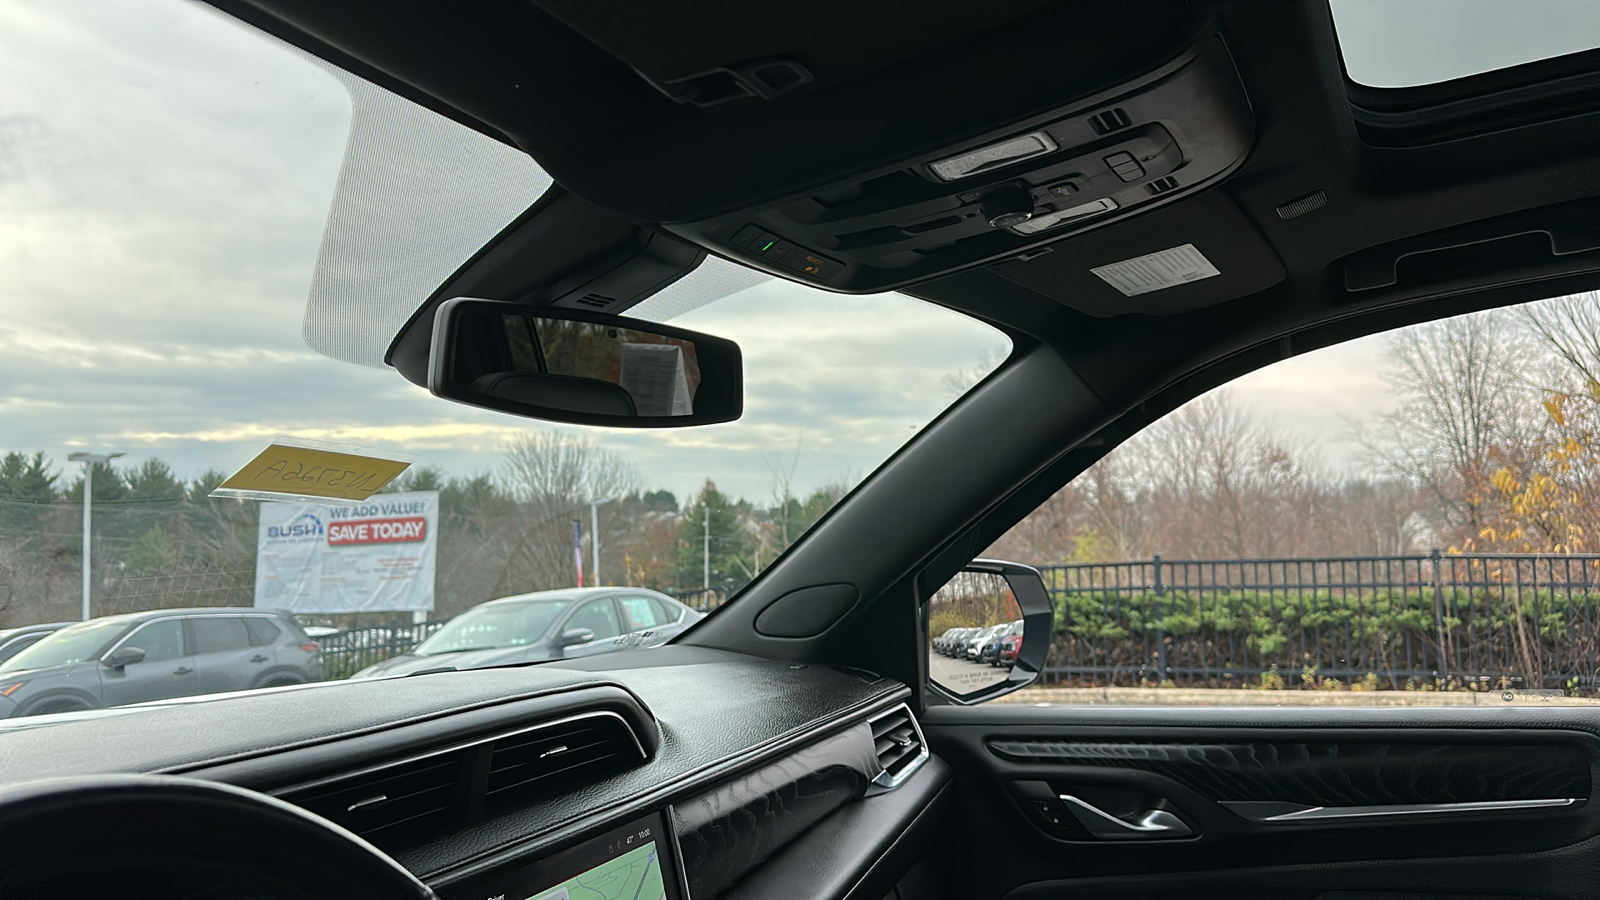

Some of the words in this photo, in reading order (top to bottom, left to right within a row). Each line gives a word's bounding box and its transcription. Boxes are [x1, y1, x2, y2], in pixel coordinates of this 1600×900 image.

[330, 507, 349, 518] WE
[352, 504, 379, 517] ADD
[381, 502, 425, 515] VALUE!
[268, 524, 317, 537] BUSH
[329, 524, 369, 542] SAVE
[370, 521, 424, 540] TODAY
